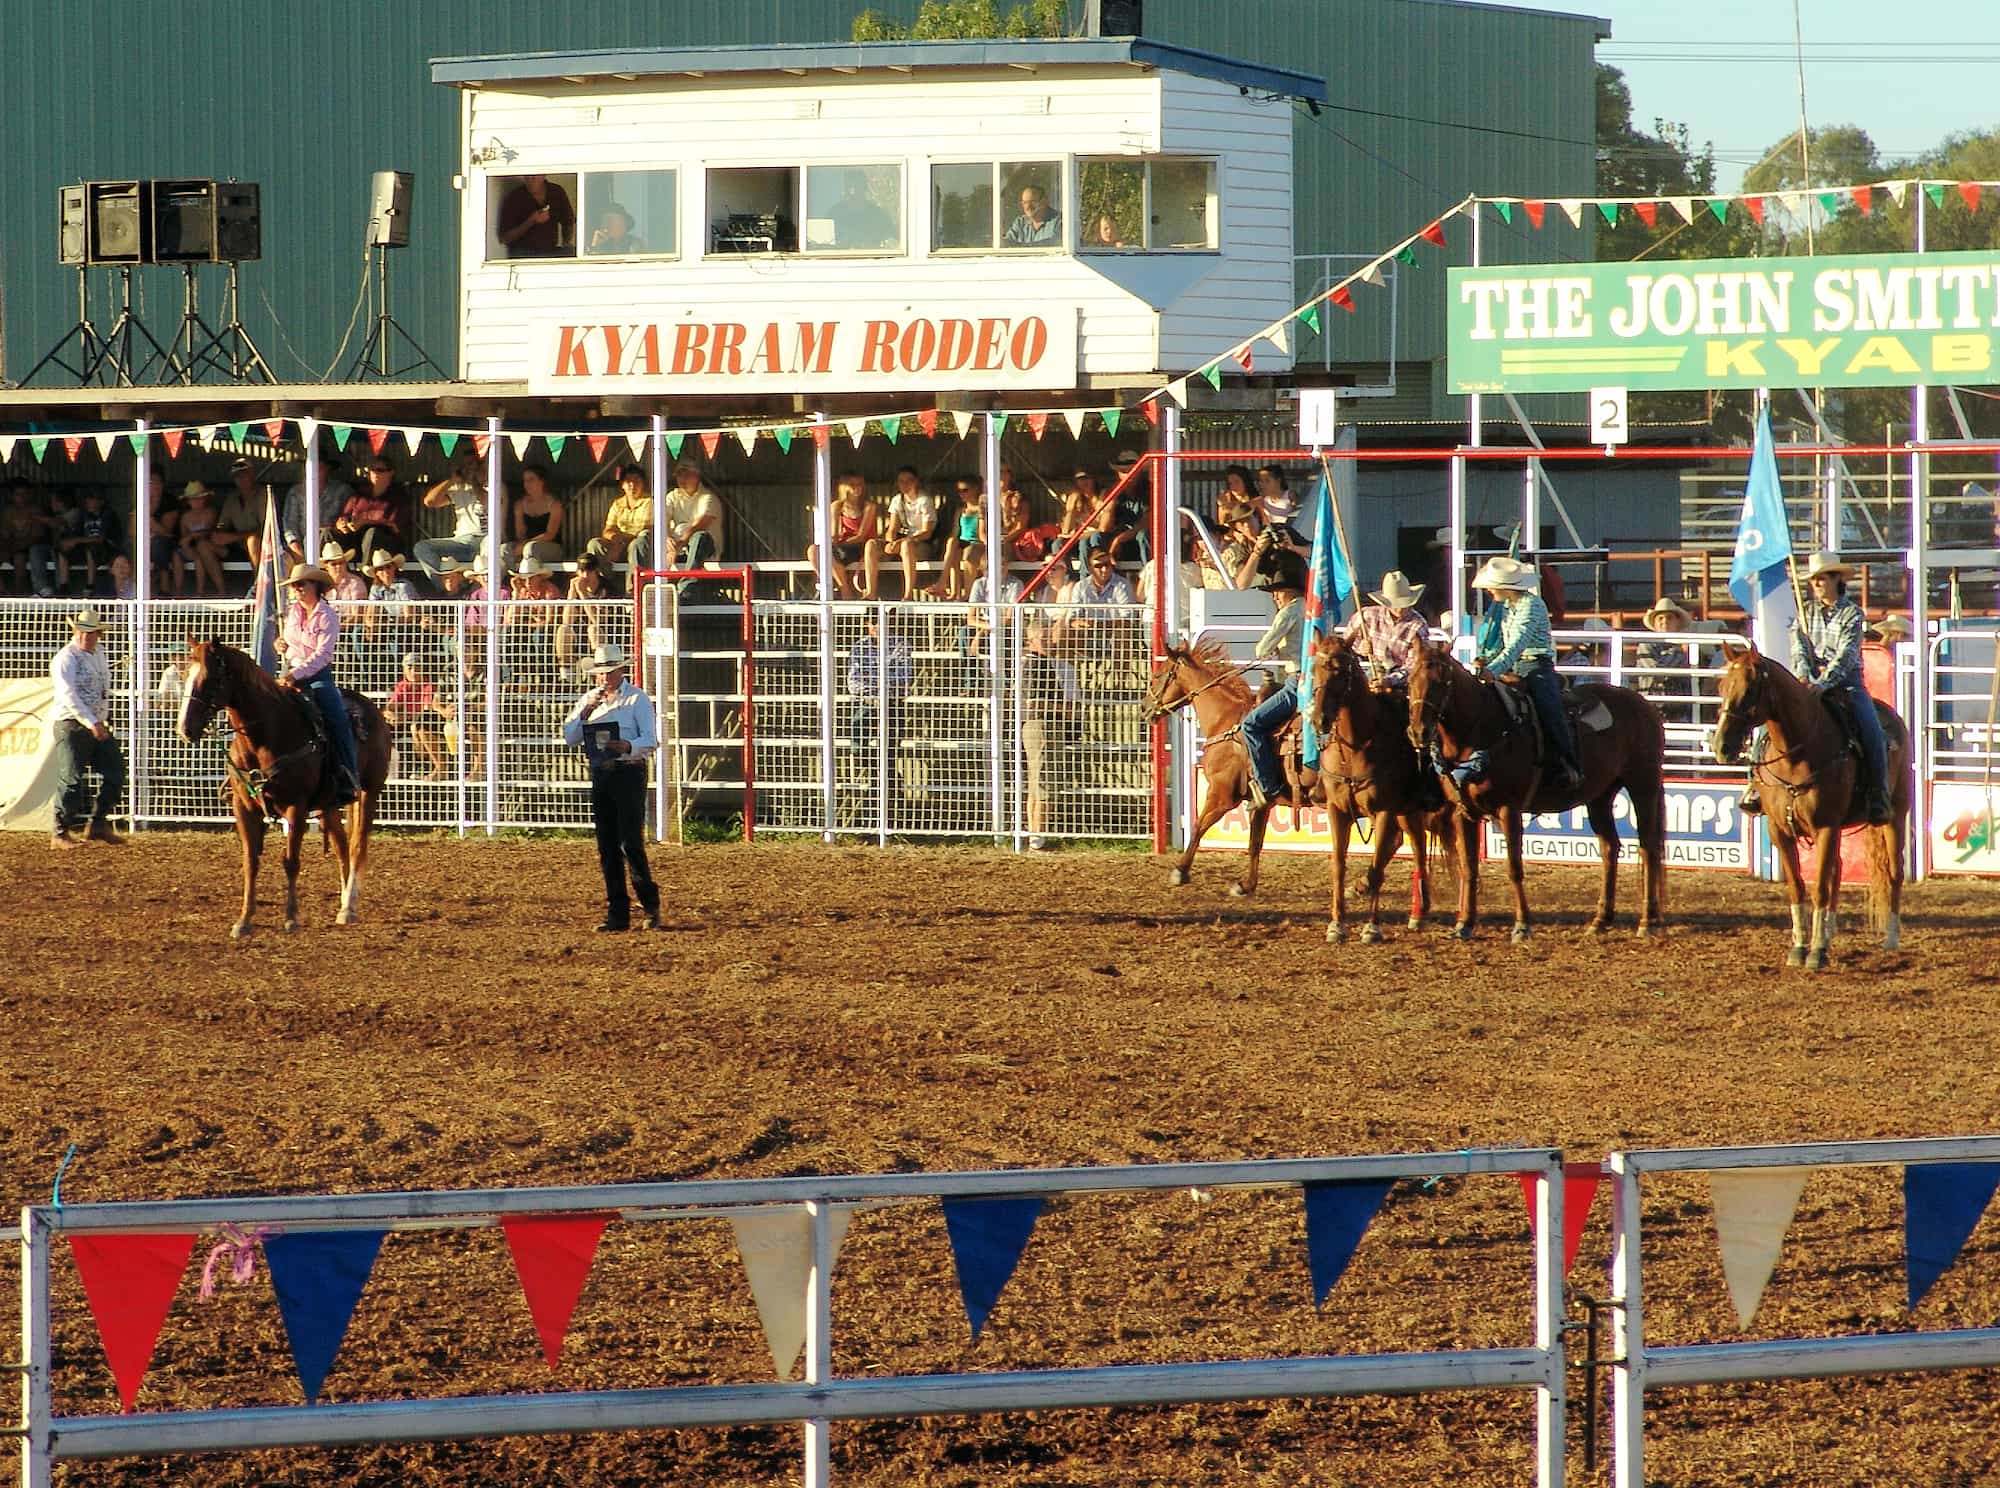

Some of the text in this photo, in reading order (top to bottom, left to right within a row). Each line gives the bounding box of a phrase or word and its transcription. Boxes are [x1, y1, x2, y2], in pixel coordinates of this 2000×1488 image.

[1461, 277, 1593, 340] THE
[1609, 270, 1794, 337] JOHN
[551, 316, 1048, 376] KYABRAM RODEO
[1705, 333, 1991, 377] KYAB
[1599, 399, 1620, 429] 2
[1494, 839, 1741, 864] IRIGATION SPIALISTS
